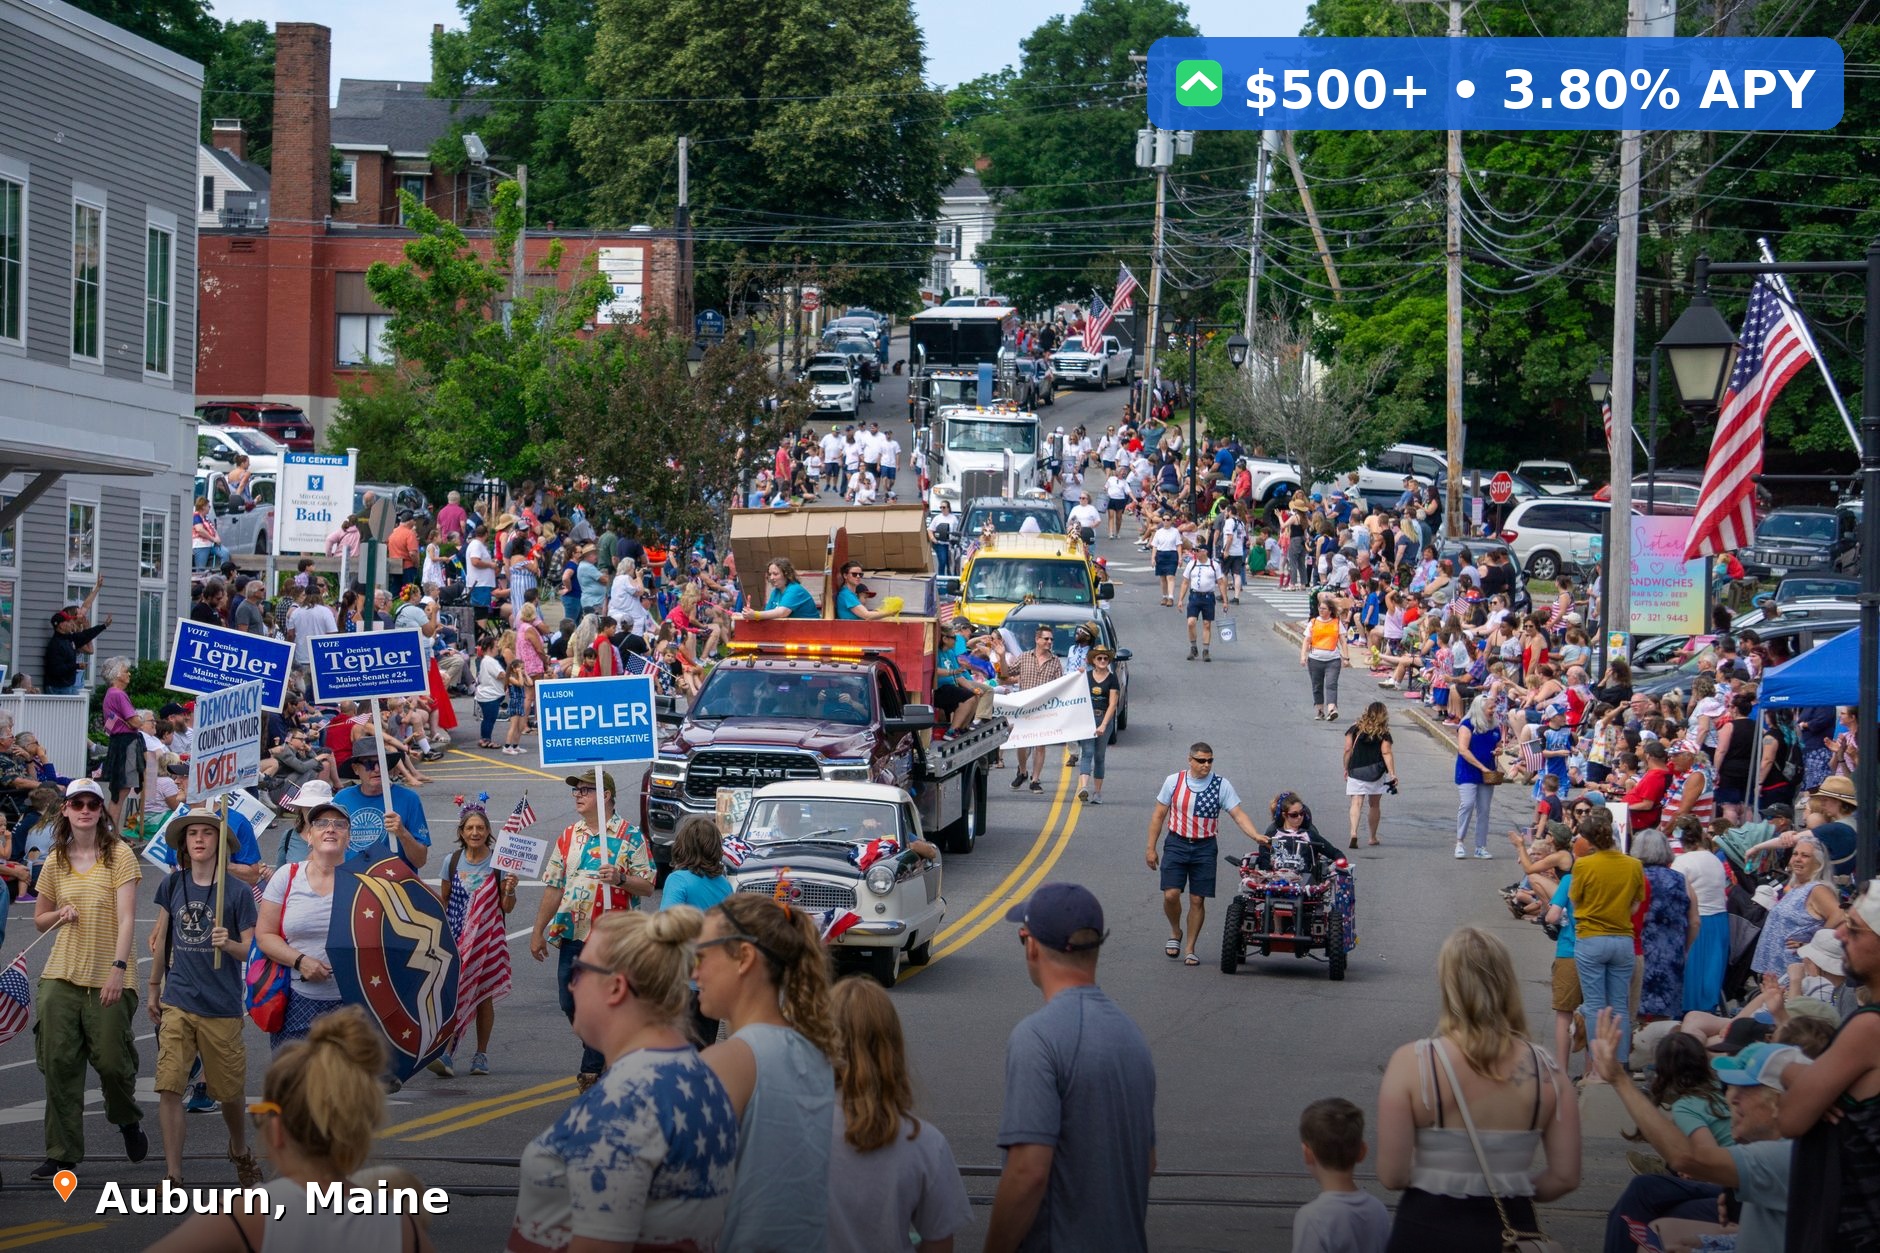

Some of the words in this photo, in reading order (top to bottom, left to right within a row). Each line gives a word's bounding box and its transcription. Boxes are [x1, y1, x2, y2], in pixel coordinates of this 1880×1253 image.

[291, 455, 306, 464] 108
[308, 457, 343, 465] CENTRE
[1491, 481, 1511, 494] STOP
[296, 507, 331, 522] Bath
[1630, 578, 1693, 588] ANDWICHES
[1630, 613, 1641, 621] 07
[187, 627, 210, 637] VOTE
[213, 641, 239, 653] Denise
[190, 639, 278, 676] Tepler
[325, 647, 412, 673] Tepler
[193, 667, 219, 679] Maine
[362, 673, 390, 681] Senate
[542, 690, 574, 699] ALLISON
[200, 685, 259, 728] DEMOCRACY
[544, 702, 649, 731] HEPLER
[198, 725, 225, 751] COUNTS
[226, 723, 238, 743] ON
[240, 717, 259, 740] YOUR
[545, 738, 572, 748] STATE
[574, 733, 650, 746] REPRESENTATIVE
[196, 752, 237, 794] VOTE!
[726, 768, 782, 778] RAM
[509, 836, 537, 846] WOMEN'S
[500, 846, 518, 857] COUNTS
[517, 850, 526, 858] ON
[525, 852, 538, 861] YOUR
[510, 844, 532, 852] RIGHTS
[497, 855, 523, 870] VOTE!
